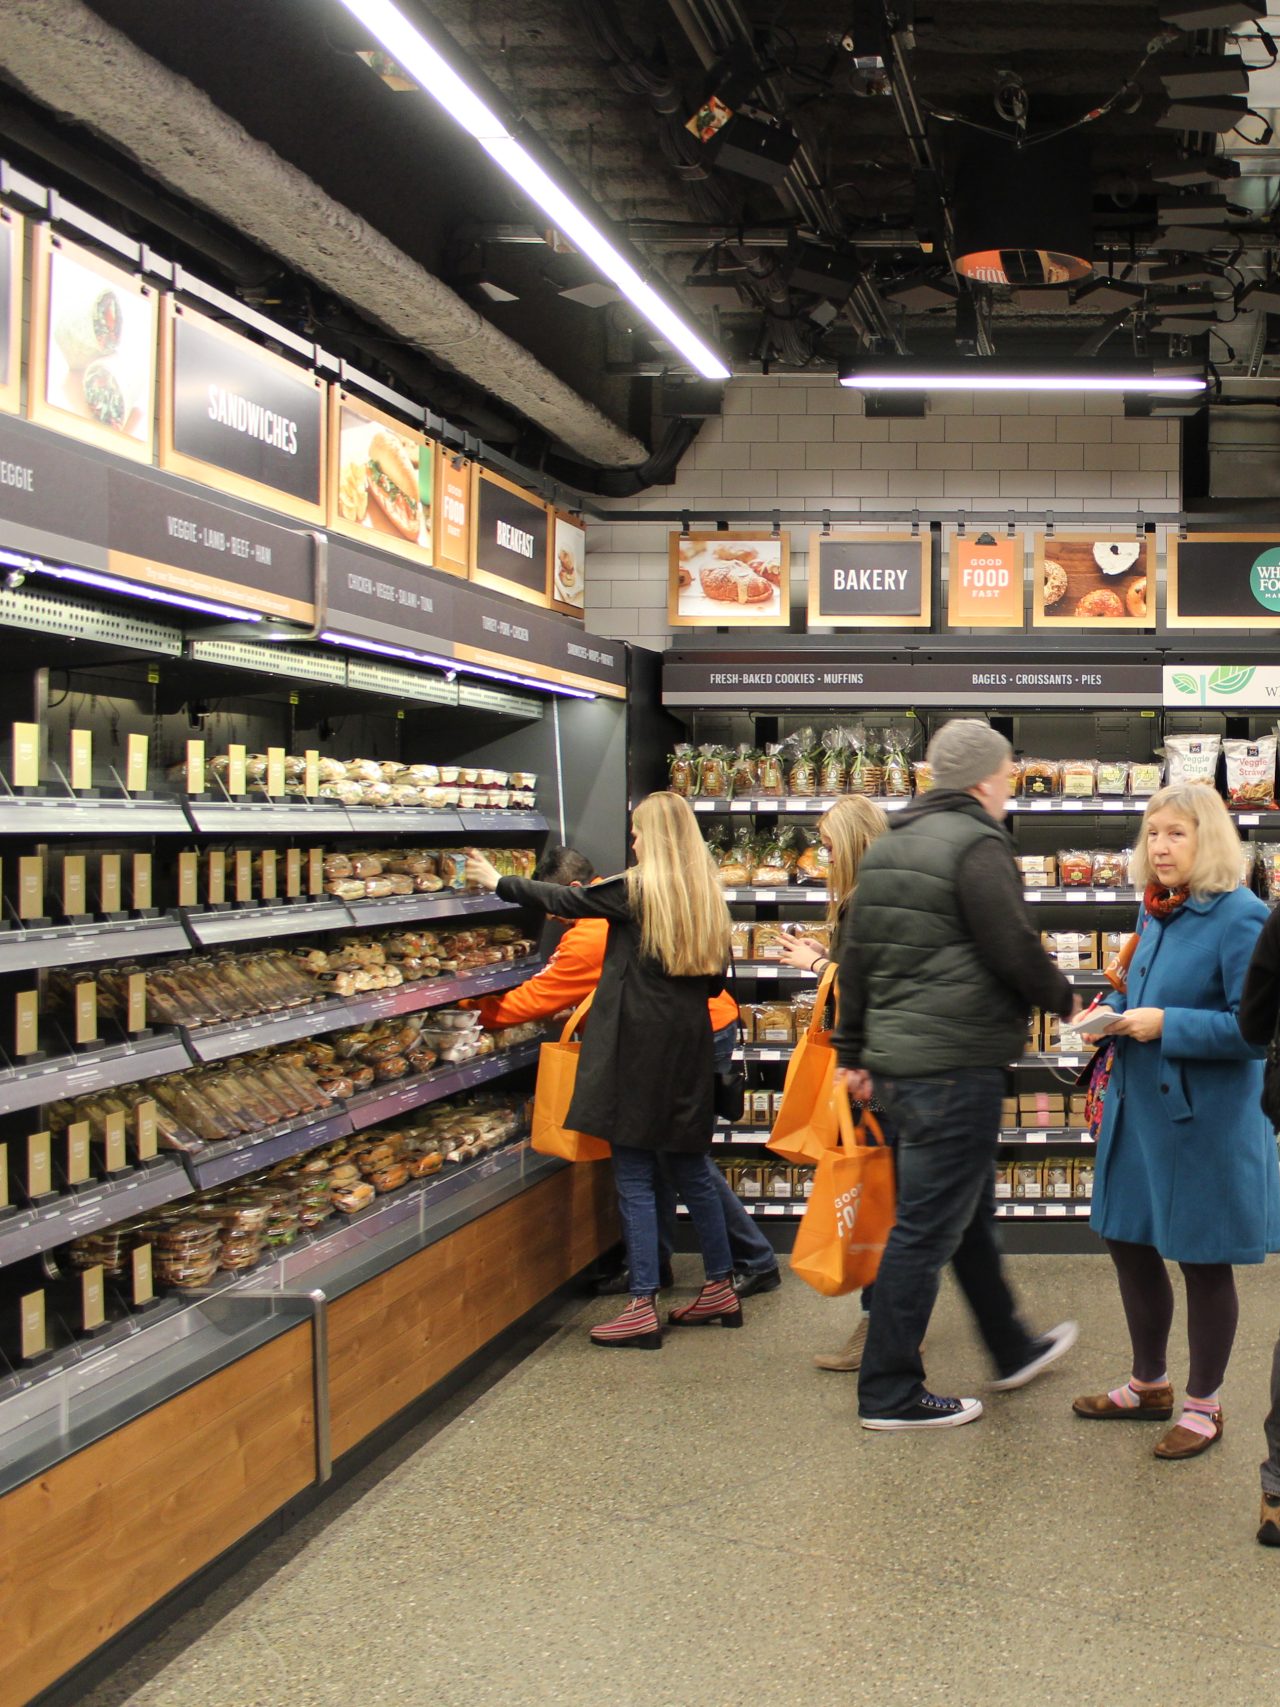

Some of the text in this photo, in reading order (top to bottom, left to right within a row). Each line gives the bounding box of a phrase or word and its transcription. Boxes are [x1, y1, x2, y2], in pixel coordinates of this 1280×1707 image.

[207, 384, 298, 455] SANDWICHES
[167, 516, 272, 565] VEGGIE LAMB BEEF HAM
[497, 520, 534, 558] BREAKFAST
[348, 573, 373, 595] CHICKEN
[833, 569, 908, 590] BAKERY
[963, 569, 1009, 587] FOOD
[972, 590, 999, 598] FAST
[710, 674, 864, 684] FRESH-BAKED COOKIES MUFFINS
[972, 674, 1102, 685] BAGELS CROISSANTS PIES
[1183, 754, 1210, 763] Veggie
[1239, 757, 1268, 767] Veggie
[1183, 765, 1208, 773] Chips
